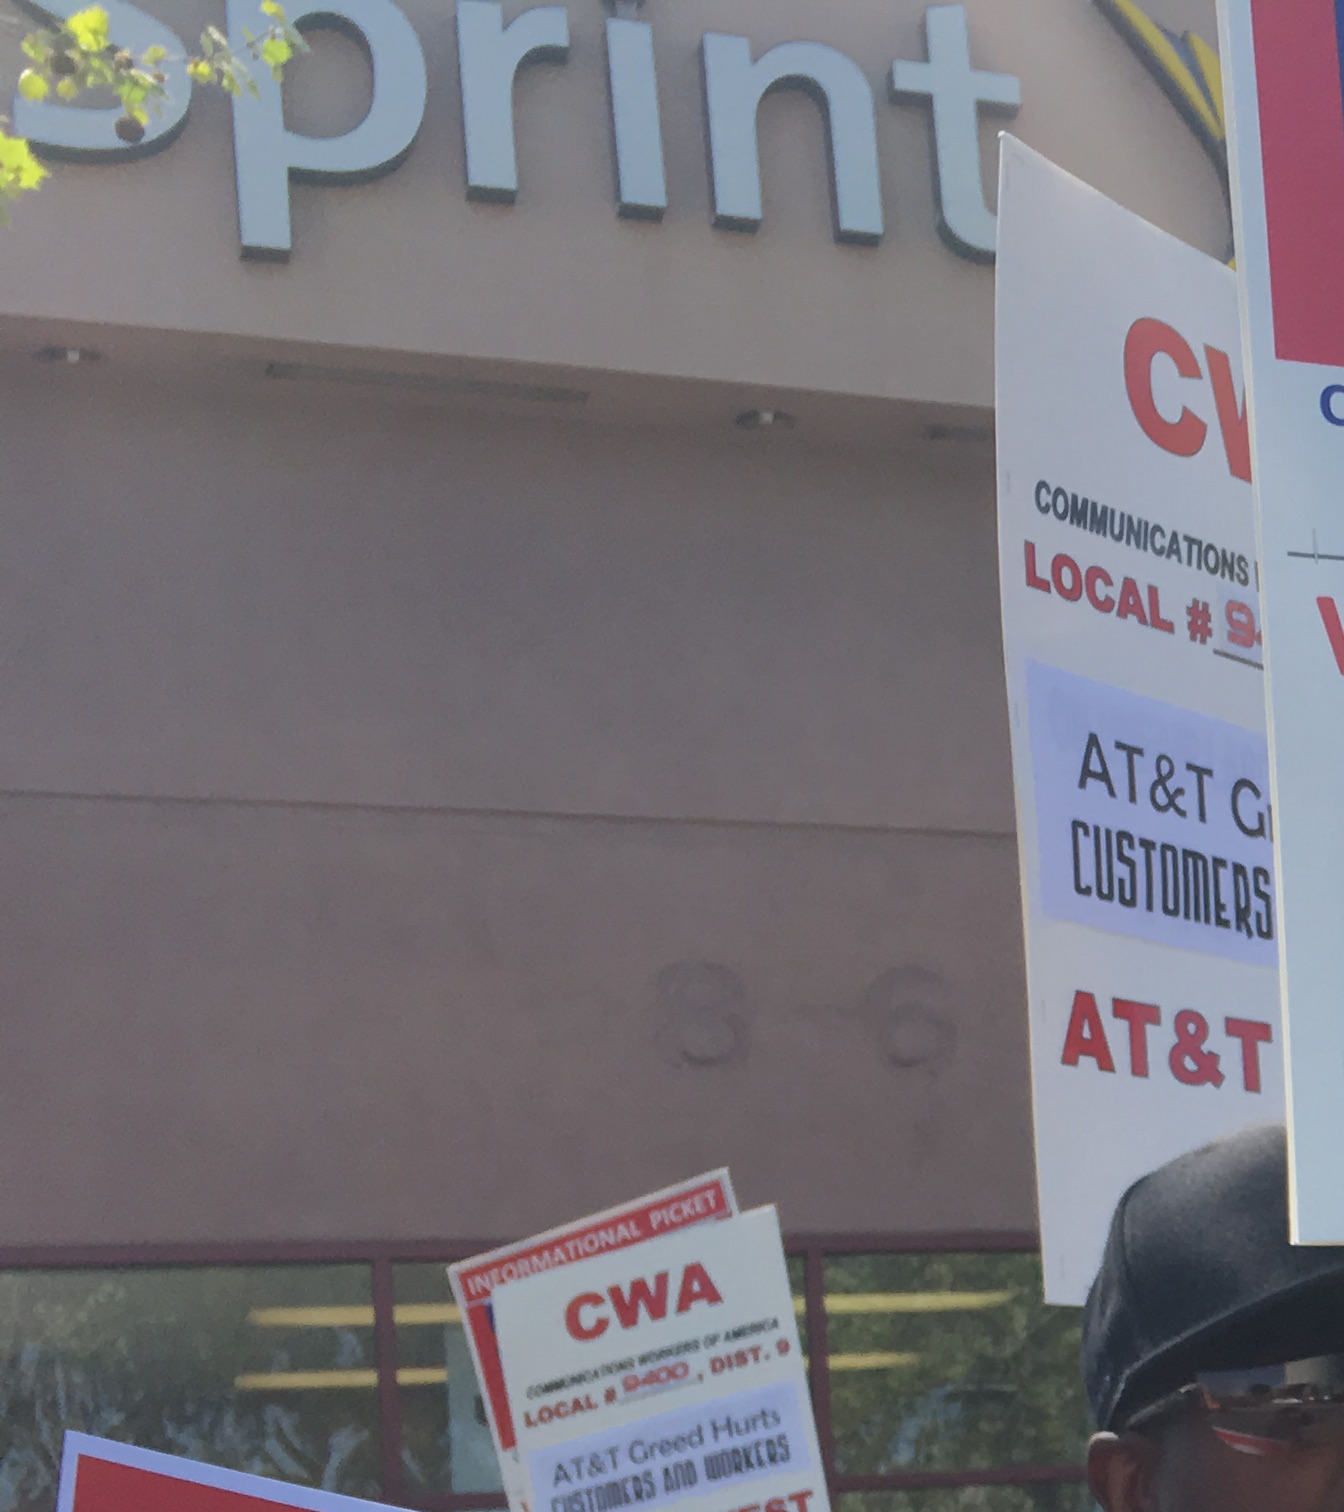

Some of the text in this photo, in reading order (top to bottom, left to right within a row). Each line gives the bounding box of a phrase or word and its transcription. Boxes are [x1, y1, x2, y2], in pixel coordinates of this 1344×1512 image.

[1035, 479, 1249, 587] COMMUNICATIONS
[1025, 540, 1175, 634] LOCAL
[1078, 732, 1213, 824] AT&T
[1071, 819, 1274, 940] CUSTOMERS
[1061, 990, 1272, 1093] AT&T
[467, 1189, 717, 1296] INFORMATIONAL PICKET
[565, 1262, 723, 1342] CWA
[524, 1394, 598, 1428] LOCAL
[552, 1406, 781, 1488] AT&T Greed Hurts
[663, 1459, 697, 1494] AND
[704, 1434, 790, 1482] WORKERS
